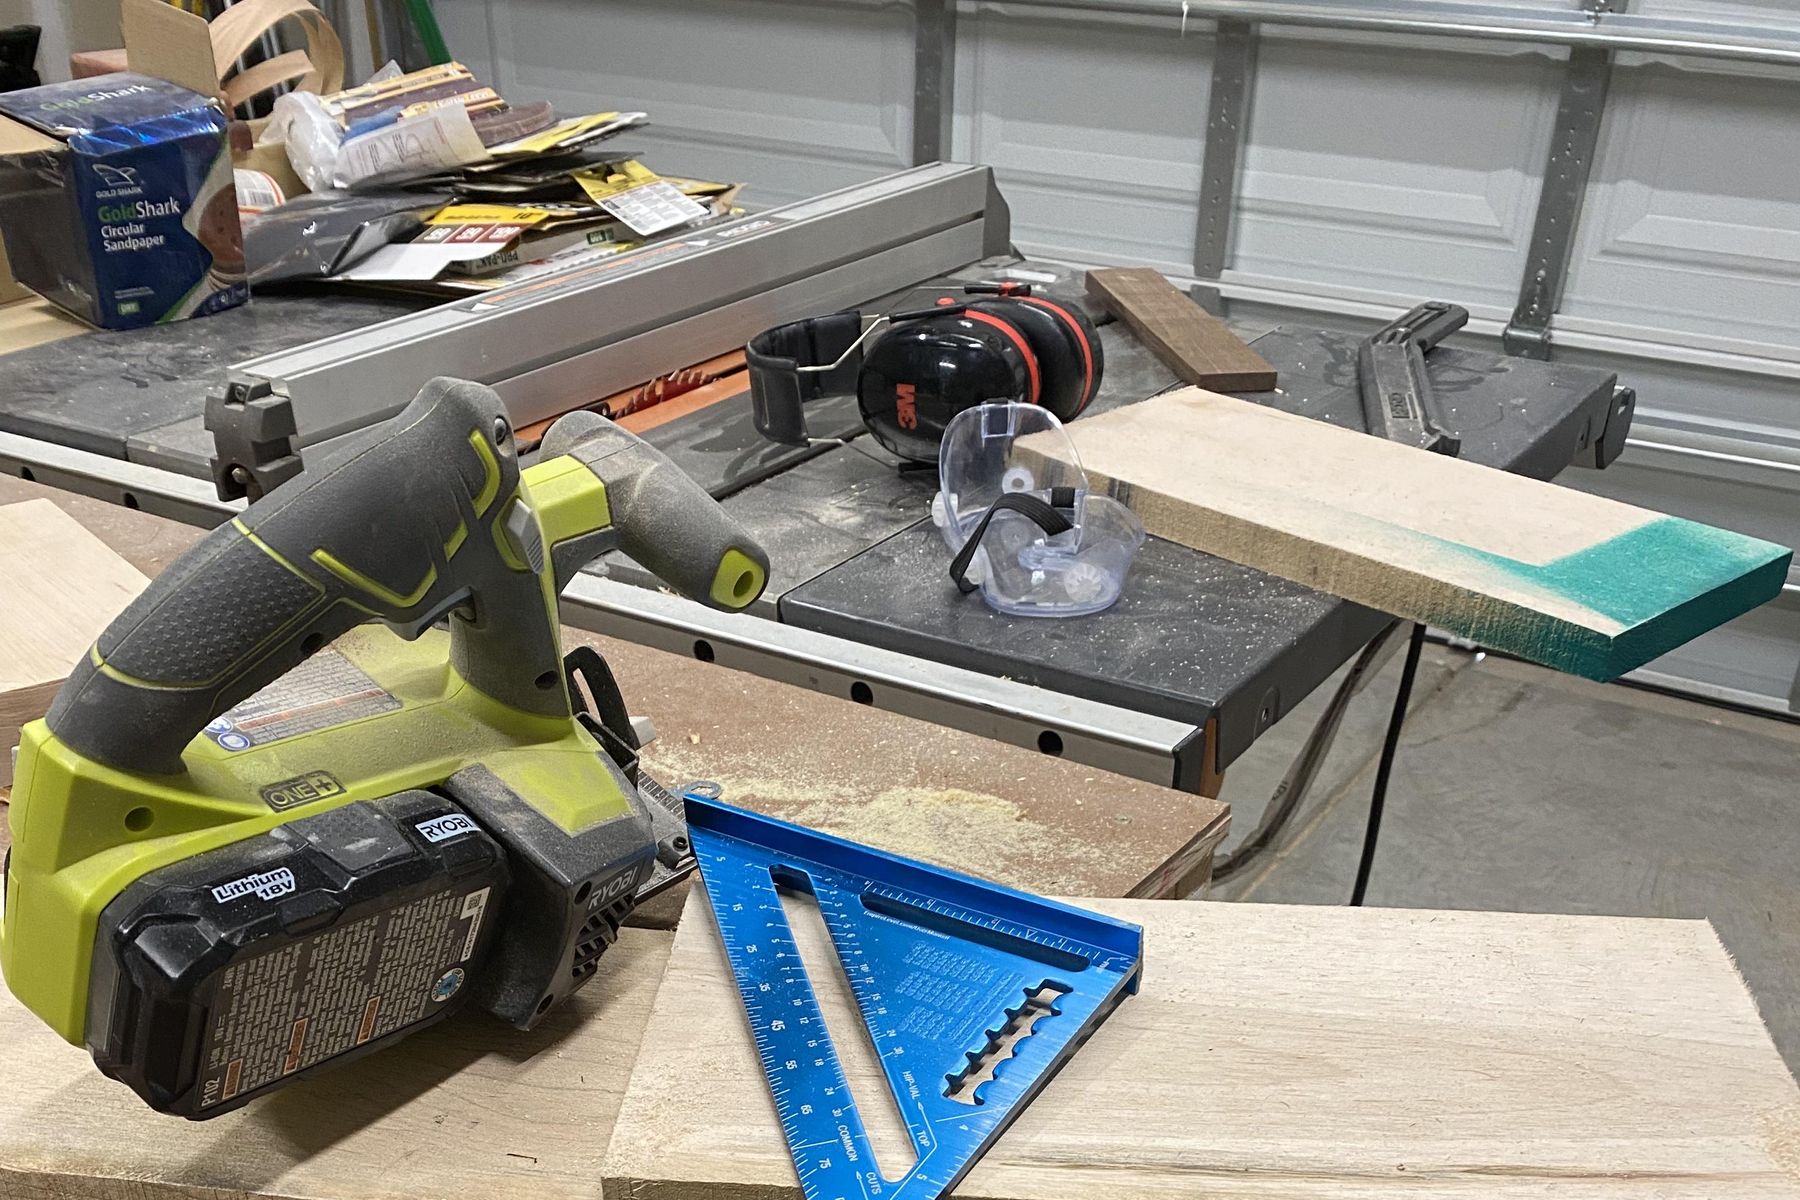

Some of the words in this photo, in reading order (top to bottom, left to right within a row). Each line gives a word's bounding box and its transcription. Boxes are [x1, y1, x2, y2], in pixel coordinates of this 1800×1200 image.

[98, 196, 181, 223] GoldShark
[101, 222, 145, 238] Circular
[103, 234, 165, 252] Sandpaper
[895, 383, 918, 431] 3M
[419, 816, 473, 840] RYOBI
[216, 868, 291, 900] Lithium
[260, 880, 294, 897] 18V
[587, 866, 639, 911] RYOBI
[732, 903, 743, 912] 15
[745, 944, 758, 953] 25
[758, 982, 771, 992] 35
[770, 1019, 786, 1032] 45
[799, 1016, 810, 1025] 12
[807, 1039, 818, 1048] 15
[785, 1059, 798, 1070] 55
[201, 1076, 221, 1108] P102
[824, 1087, 835, 1096] 24
[800, 1104, 813, 1115] 65
[831, 1108, 843, 1118] 30
[916, 1129, 931, 1148] TOP
[818, 1158, 832, 1170] 75
[837, 1124, 859, 1162] COMMON
[865, 1171, 882, 1195] CUTS
[916, 1173, 928, 1181] 5
